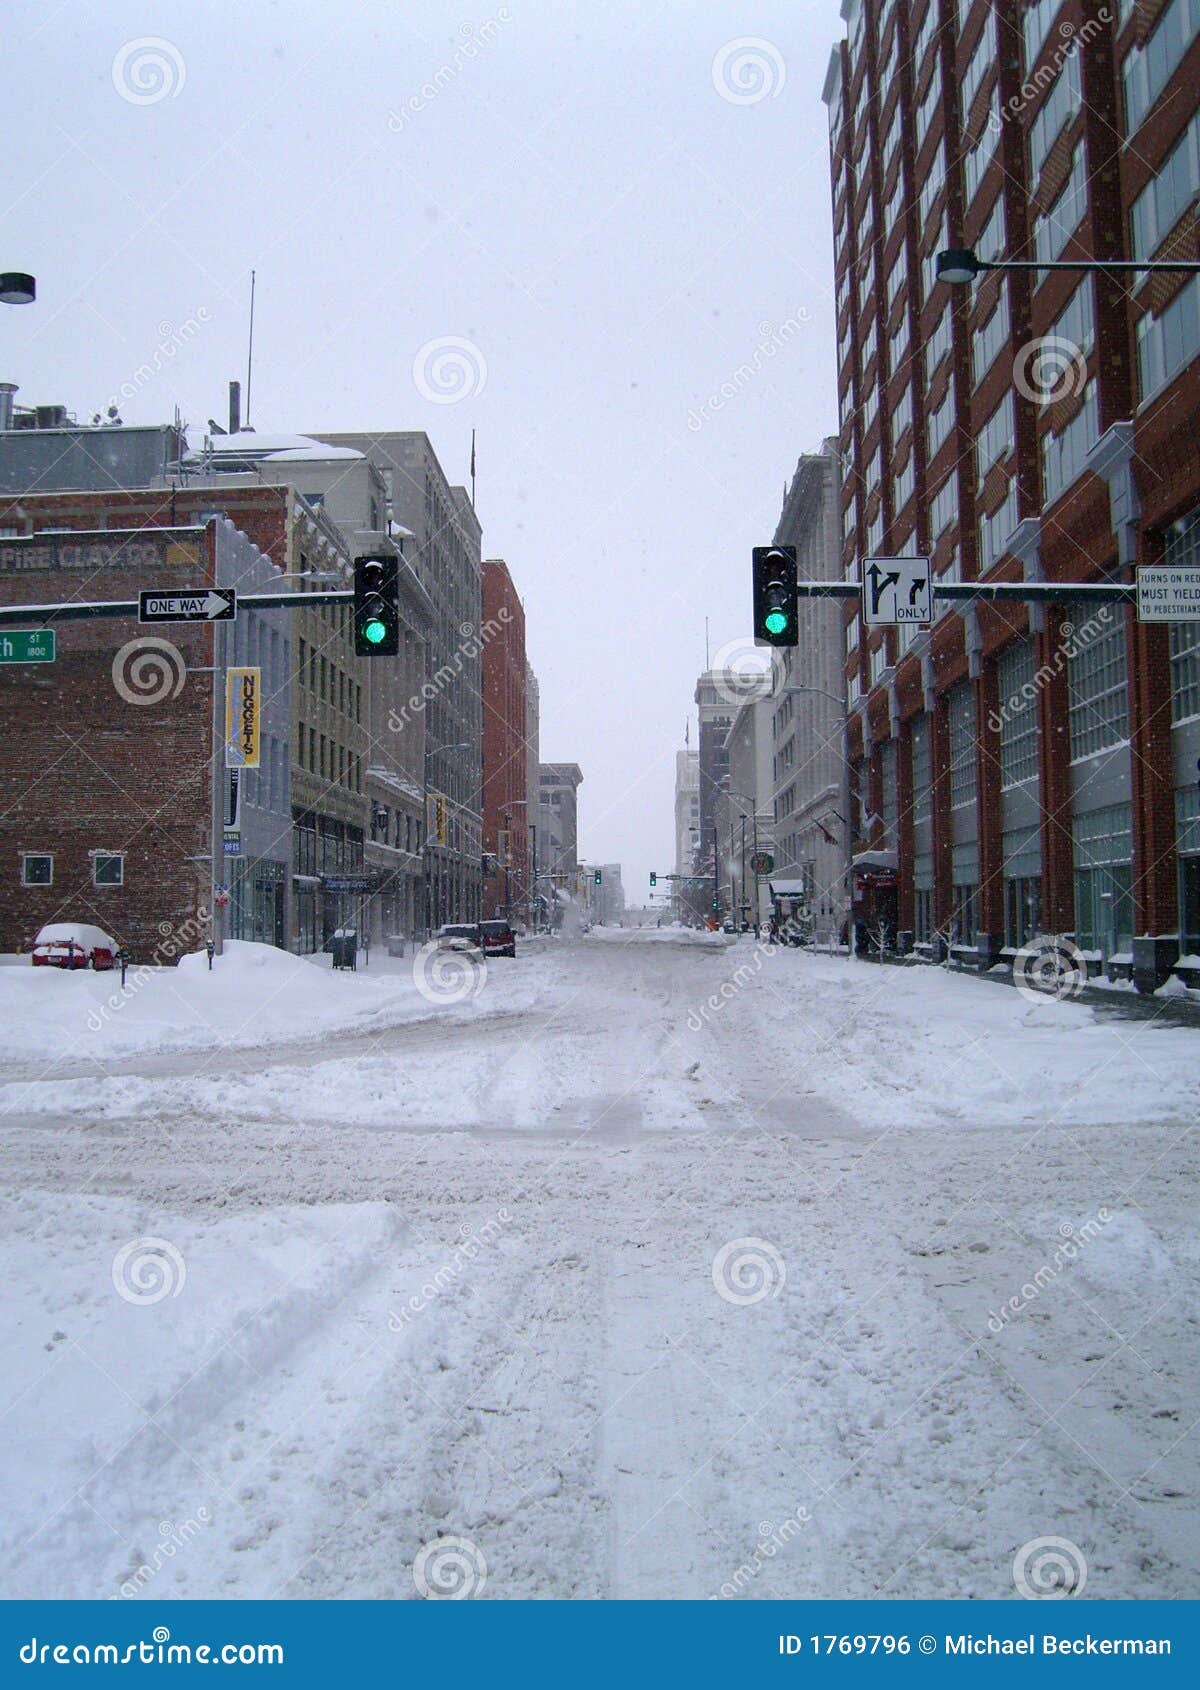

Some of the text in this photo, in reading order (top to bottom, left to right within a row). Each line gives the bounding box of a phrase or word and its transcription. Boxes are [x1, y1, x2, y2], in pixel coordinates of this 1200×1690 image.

[1141, 574, 1200, 583] TURNS ON RED
[1141, 589, 1200, 600] MUST YIELD
[150, 599, 206, 613] ONE WAY
[1142, 605, 1151, 614] TO
[898, 608, 928, 618] ONLY
[30, 634, 40, 643] ST
[243, 675, 255, 755] NUGGETS
